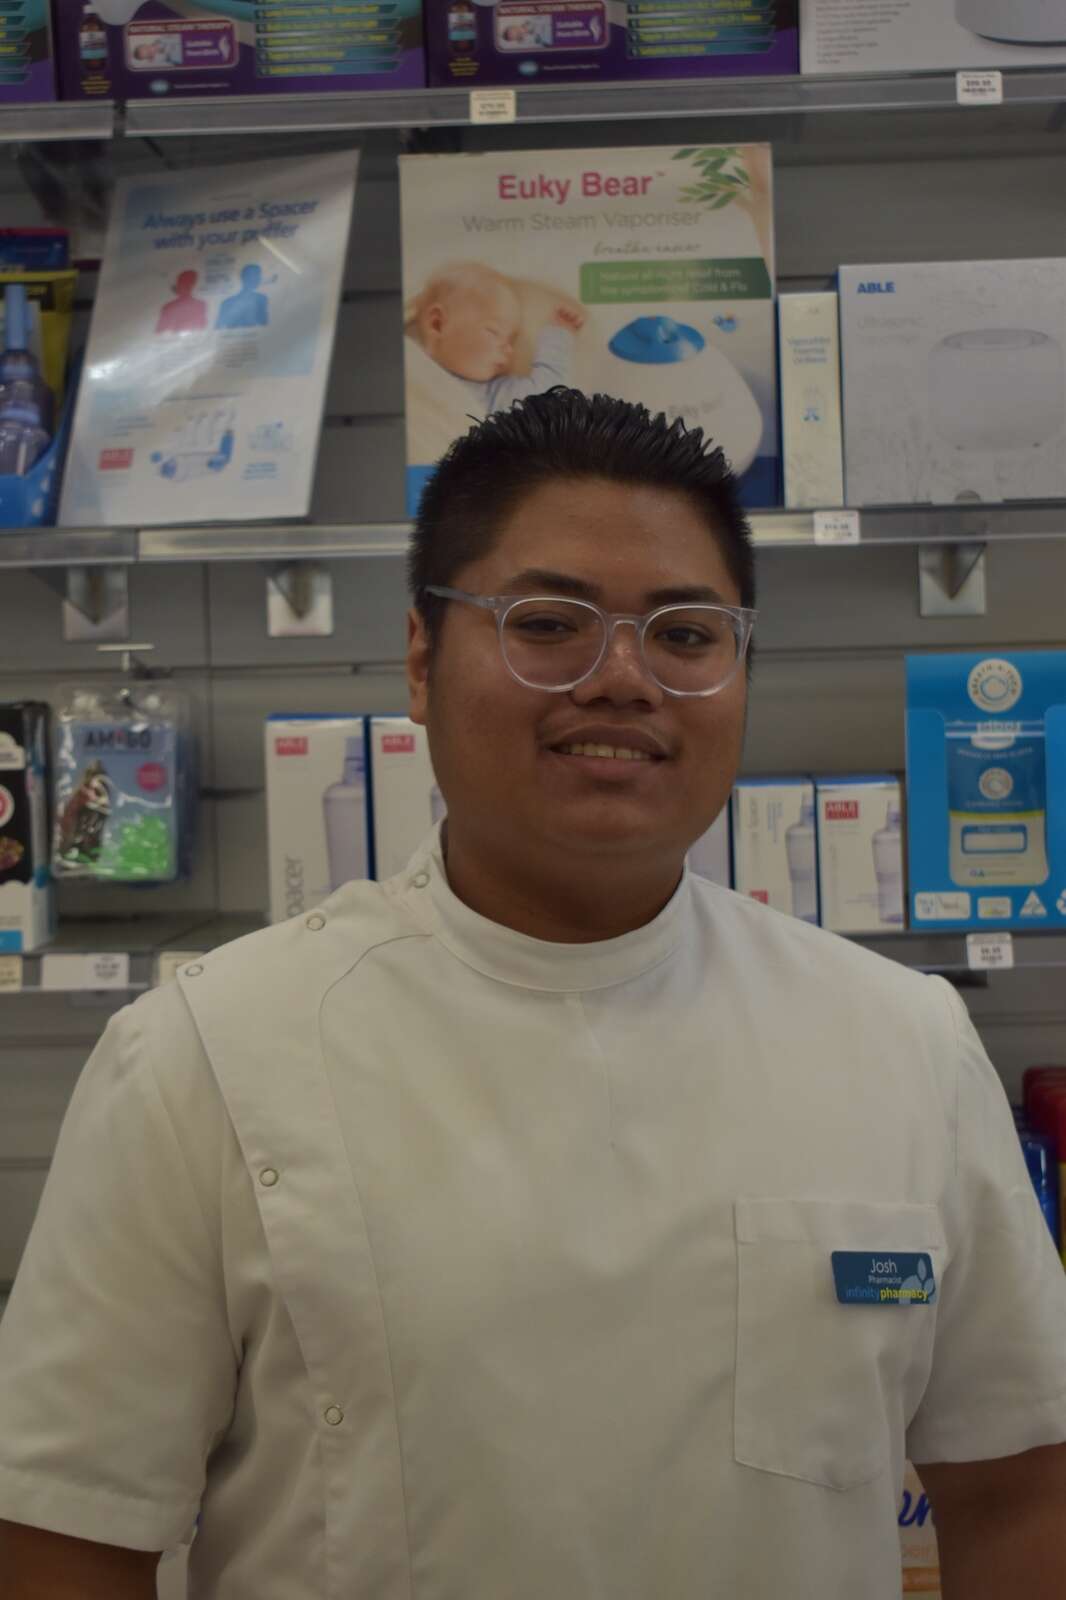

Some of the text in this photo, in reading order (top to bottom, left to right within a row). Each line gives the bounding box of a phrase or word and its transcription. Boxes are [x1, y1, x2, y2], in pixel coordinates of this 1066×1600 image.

[497, 171, 653, 205] Euky Bear
[142, 212, 206, 233] Always
[208, 208, 241, 223] use
[258, 201, 318, 223] Spacer
[461, 208, 703, 232] Warm Steam Vaporiser
[153, 230, 195, 250] with
[196, 230, 239, 251] your
[856, 281, 897, 295] ABLE
[285, 854, 304, 919] pacer
[871, 1258, 897, 1274] Josh
[880, 1287, 929, 1302] pharmacy
